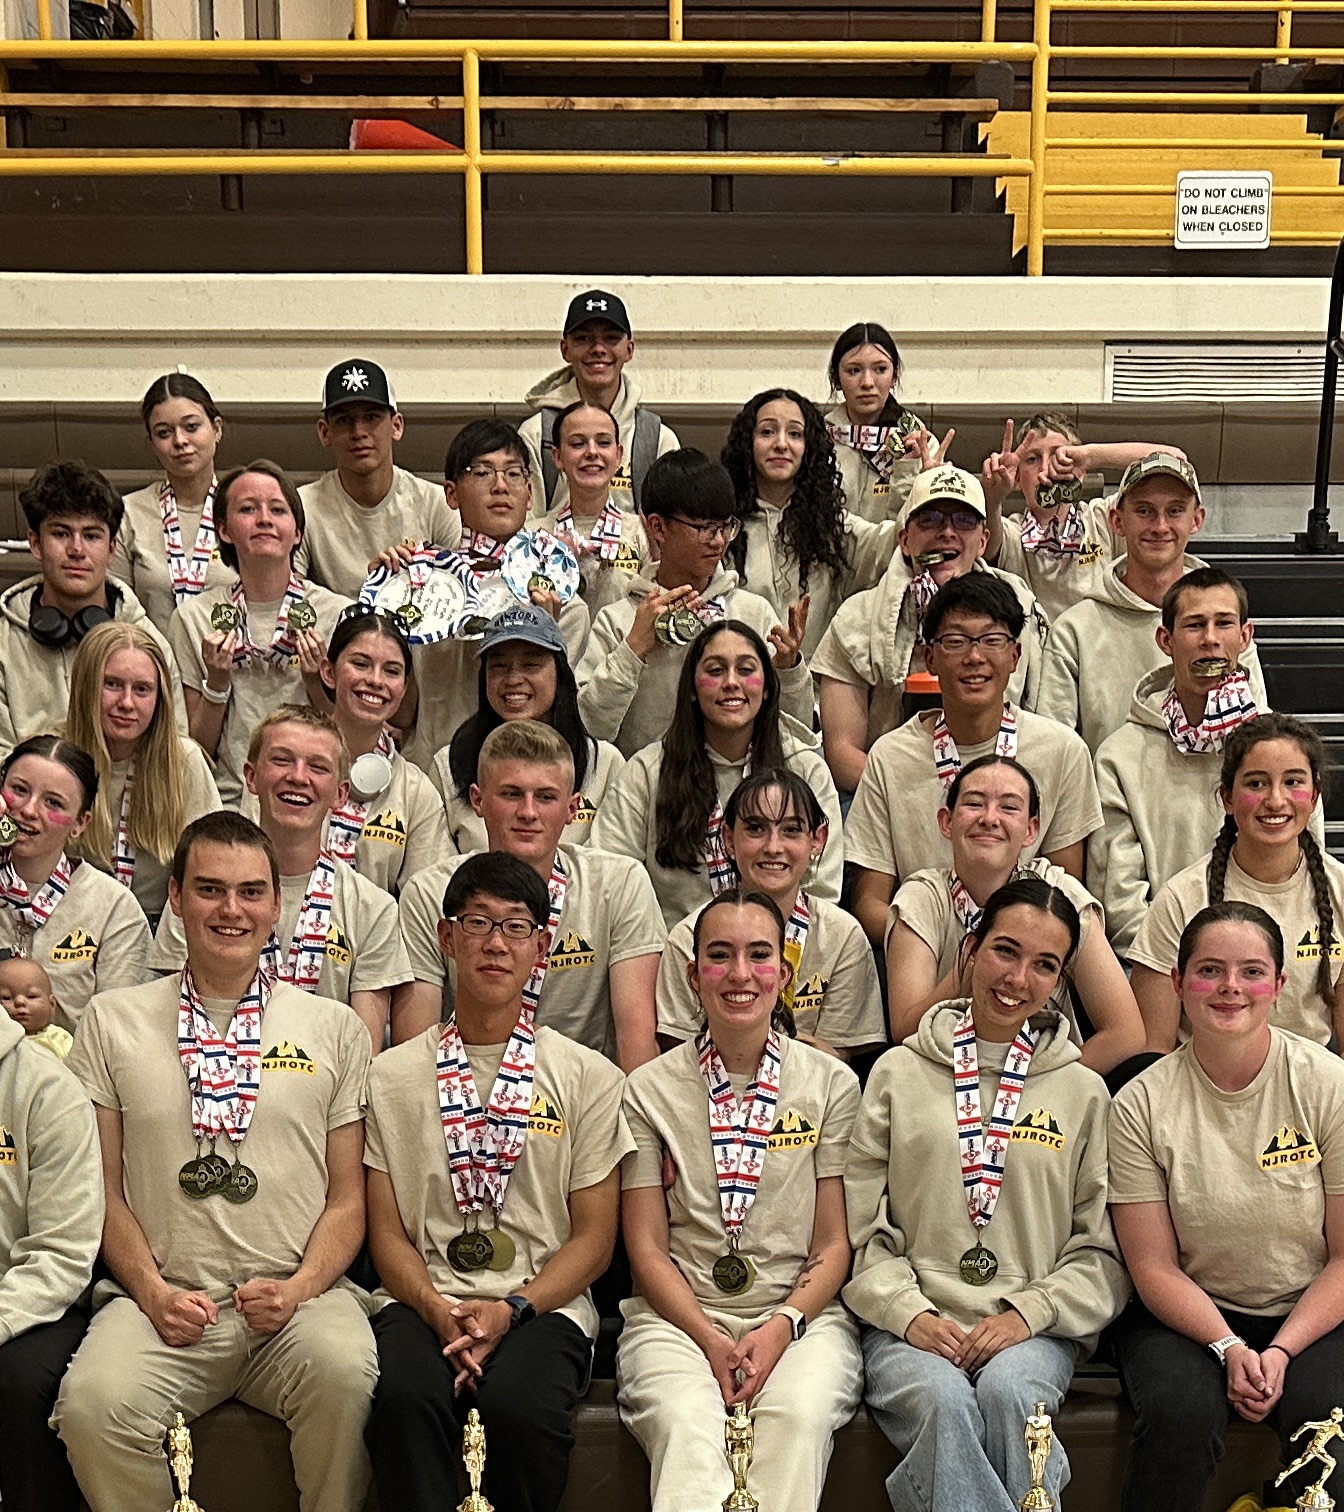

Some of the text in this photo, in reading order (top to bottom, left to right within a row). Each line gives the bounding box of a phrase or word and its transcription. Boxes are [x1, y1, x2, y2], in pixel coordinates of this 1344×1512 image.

[1184, 188, 1264, 198] DO NOT CLIMB
[1181, 204, 1265, 215] ON BLEACHERS
[1182, 221, 1263, 232] WHEN CLOSED
[363, 829, 406, 846] NJROTC
[550, 955, 595, 969] NJROTC
[262, 1061, 315, 1074] NJROTC
[768, 1133, 816, 1149] NJROTC
[1012, 1131, 1063, 1150] NJROTC
[1261, 1149, 1315, 1169] NJROTC
